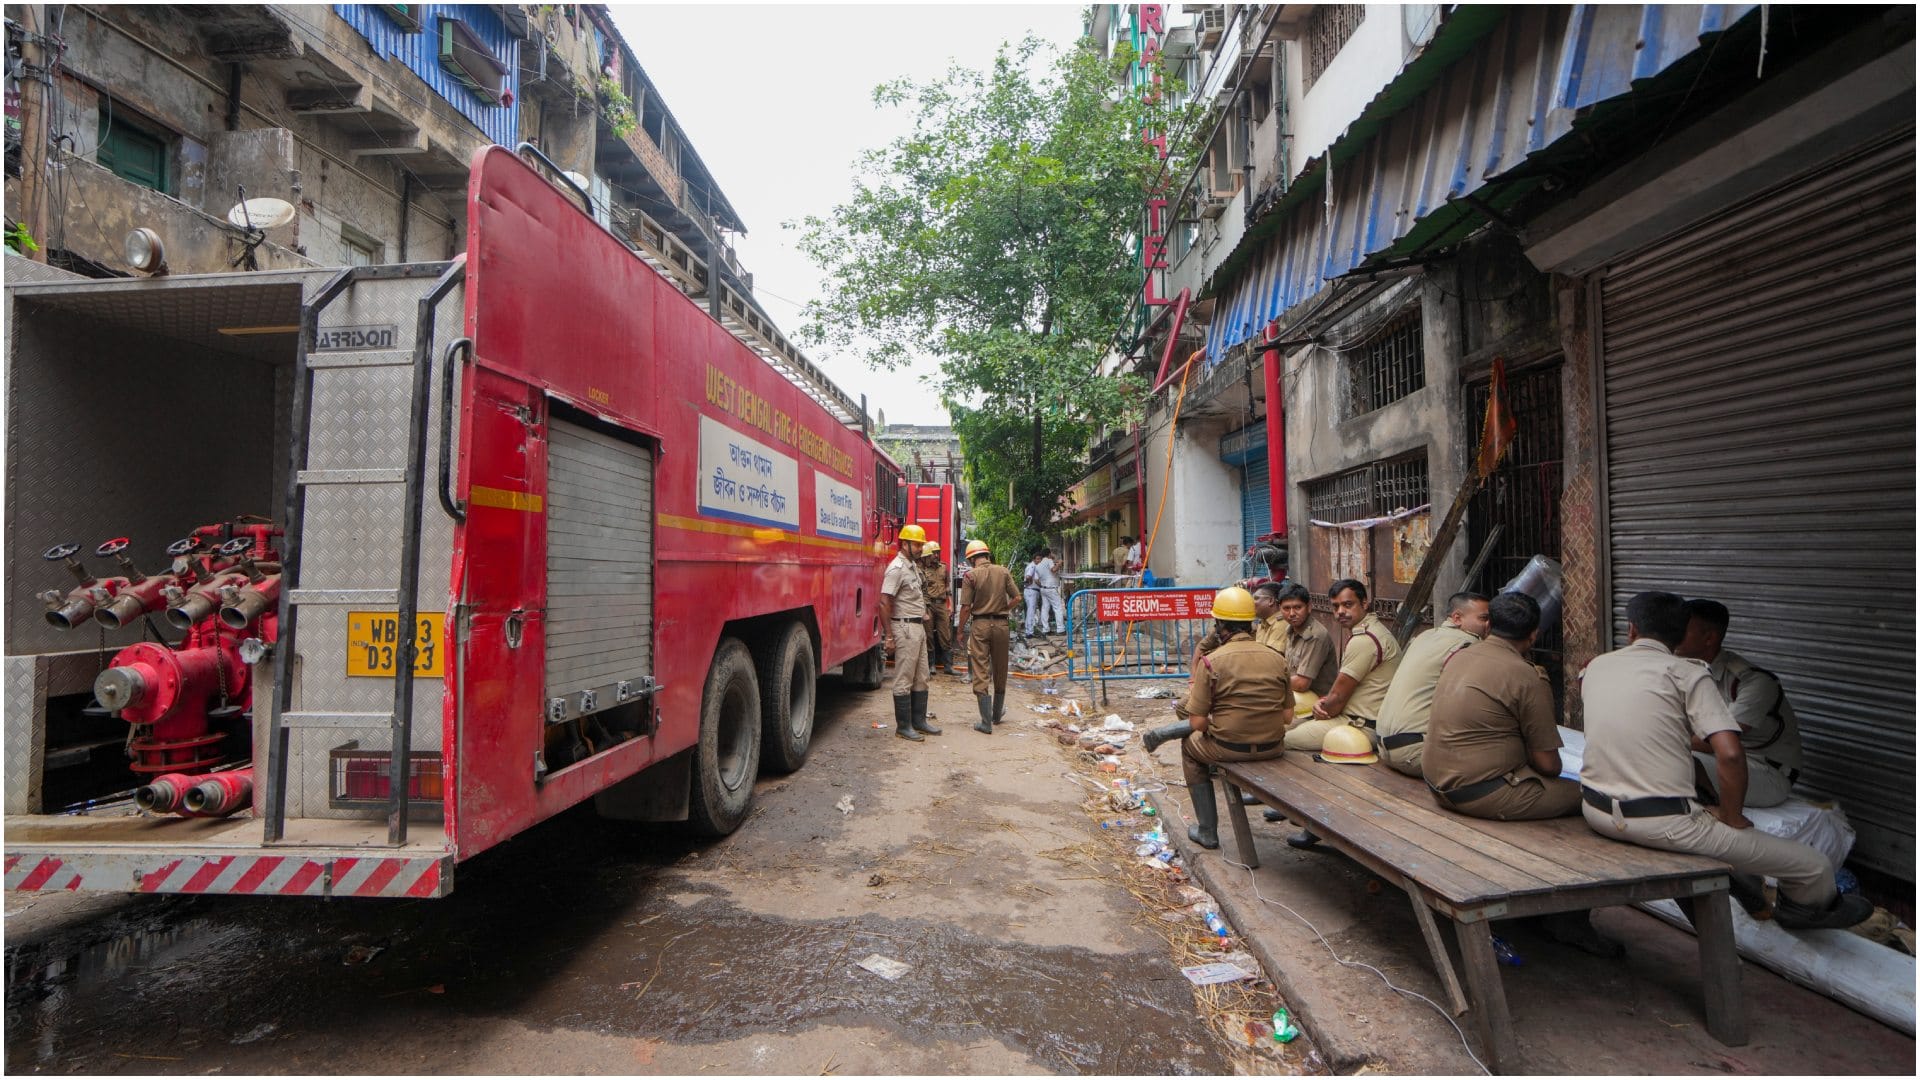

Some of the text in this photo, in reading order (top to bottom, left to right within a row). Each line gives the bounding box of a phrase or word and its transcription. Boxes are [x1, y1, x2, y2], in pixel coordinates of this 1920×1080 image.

[317, 329, 392, 348] ARRISON
[588, 385, 608, 405] LOCKER
[706, 363, 736, 416] WEST
[775, 408, 791, 445] FIRE
[799, 424, 832, 466] EMERGENCY
[832, 446, 854, 479] SERVICES
[728, 442, 773, 479] আগুন থামান
[713, 466, 736, 504] জীবন
[738, 484, 745, 503] ও
[746, 483, 770, 509] সম্পত্তি
[820, 508, 831, 525] Save
[1122, 599, 1159, 613] SERUM
[368, 645, 435, 671] D323
